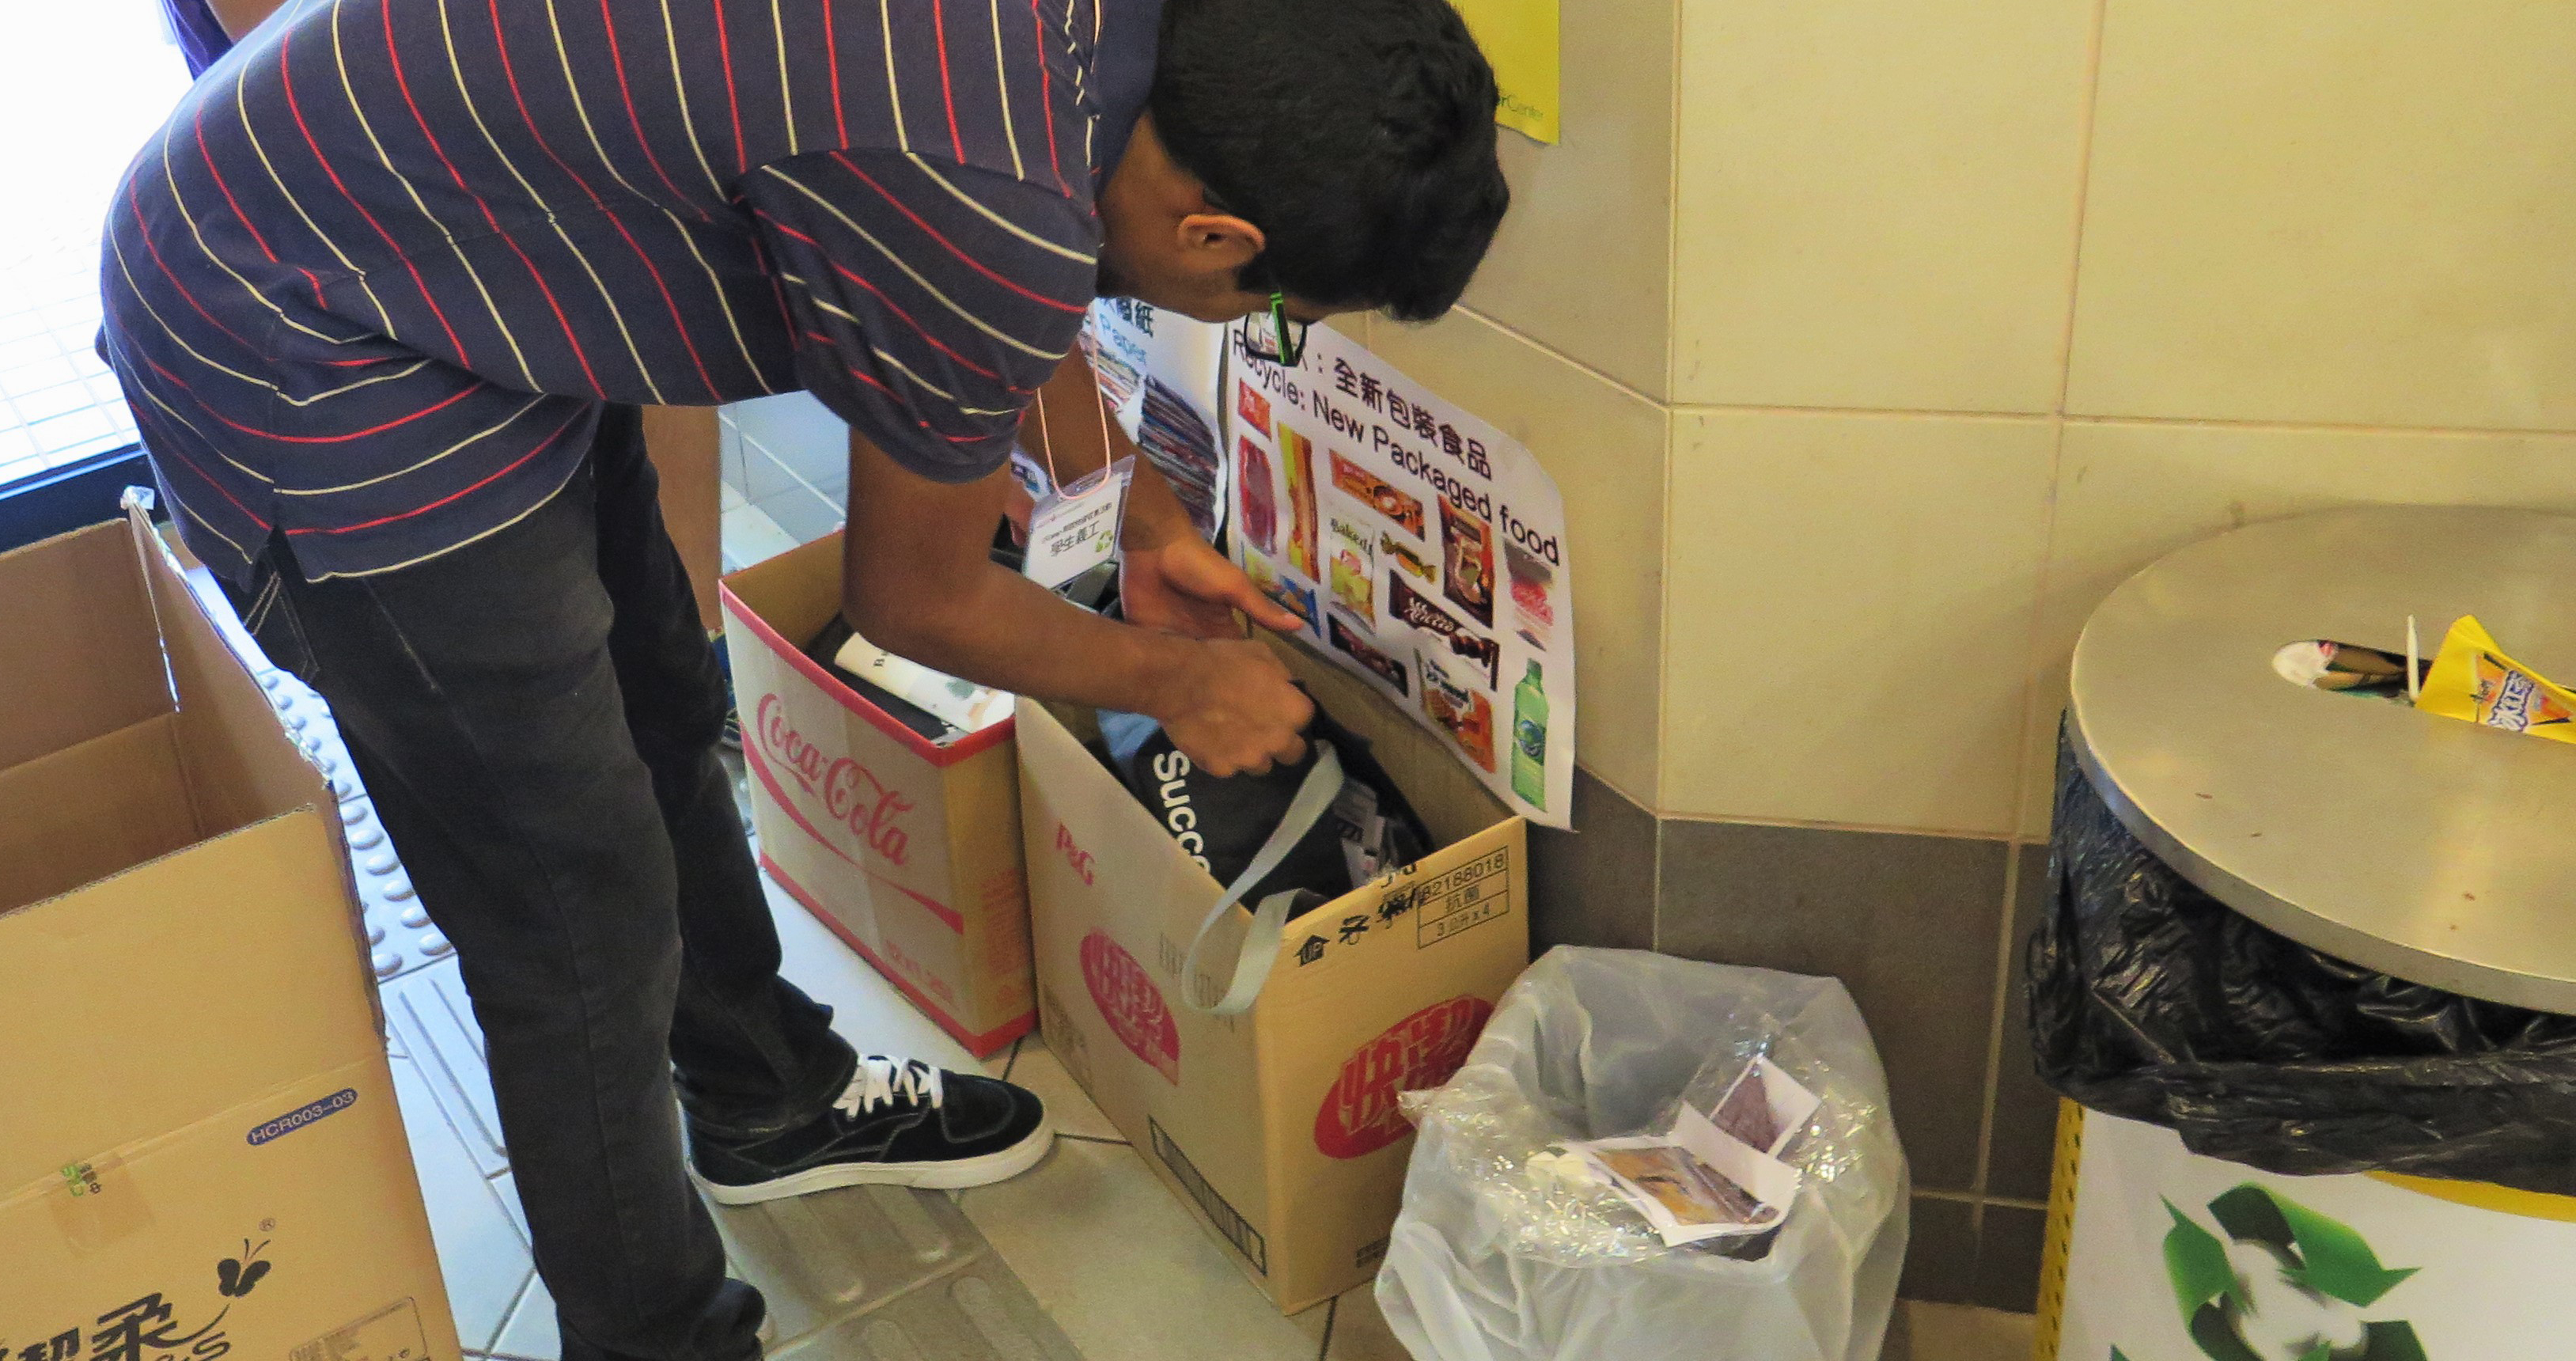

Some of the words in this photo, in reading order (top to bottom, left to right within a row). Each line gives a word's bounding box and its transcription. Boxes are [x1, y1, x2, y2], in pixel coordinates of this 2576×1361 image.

[1313, 389, 1364, 443] New
[1373, 424, 1492, 524] Packaged
[1499, 503, 1560, 567] food
